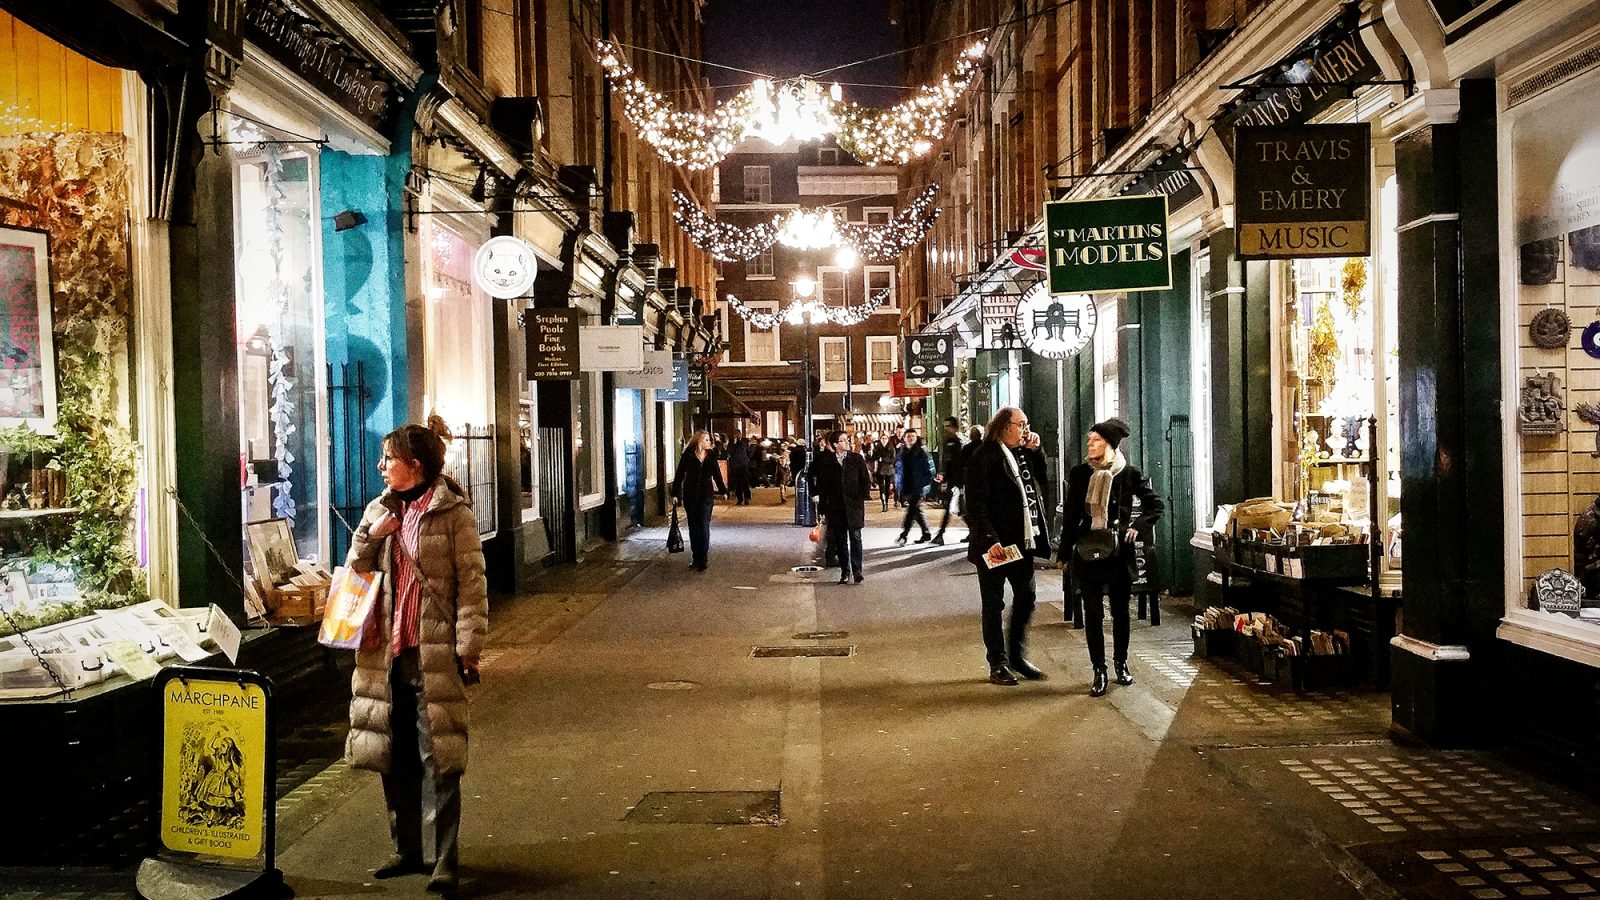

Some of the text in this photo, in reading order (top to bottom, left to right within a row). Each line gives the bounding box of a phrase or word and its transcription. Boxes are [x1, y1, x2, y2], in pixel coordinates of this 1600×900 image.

[1285, 86, 1302, 113] &
[1255, 139, 1351, 163] TRAVIS
[1291, 165, 1314, 185] &
[1259, 188, 1346, 211] EMERY
[1067, 223, 1163, 243] MARTINS
[1258, 226, 1349, 250] MUSIC
[1055, 242, 1164, 267] MODELS
[983, 306, 1016, 315] MILIT
[540, 324, 564, 333] Poole
[544, 334, 561, 342] Fine
[1018, 312, 1034, 348] MEDAL
[539, 343, 567, 352] Books
[170, 691, 259, 710] MARCHPANE
[209, 840, 232, 849] BOOKS
[211, 830, 251, 842] ILLUSTRATED
